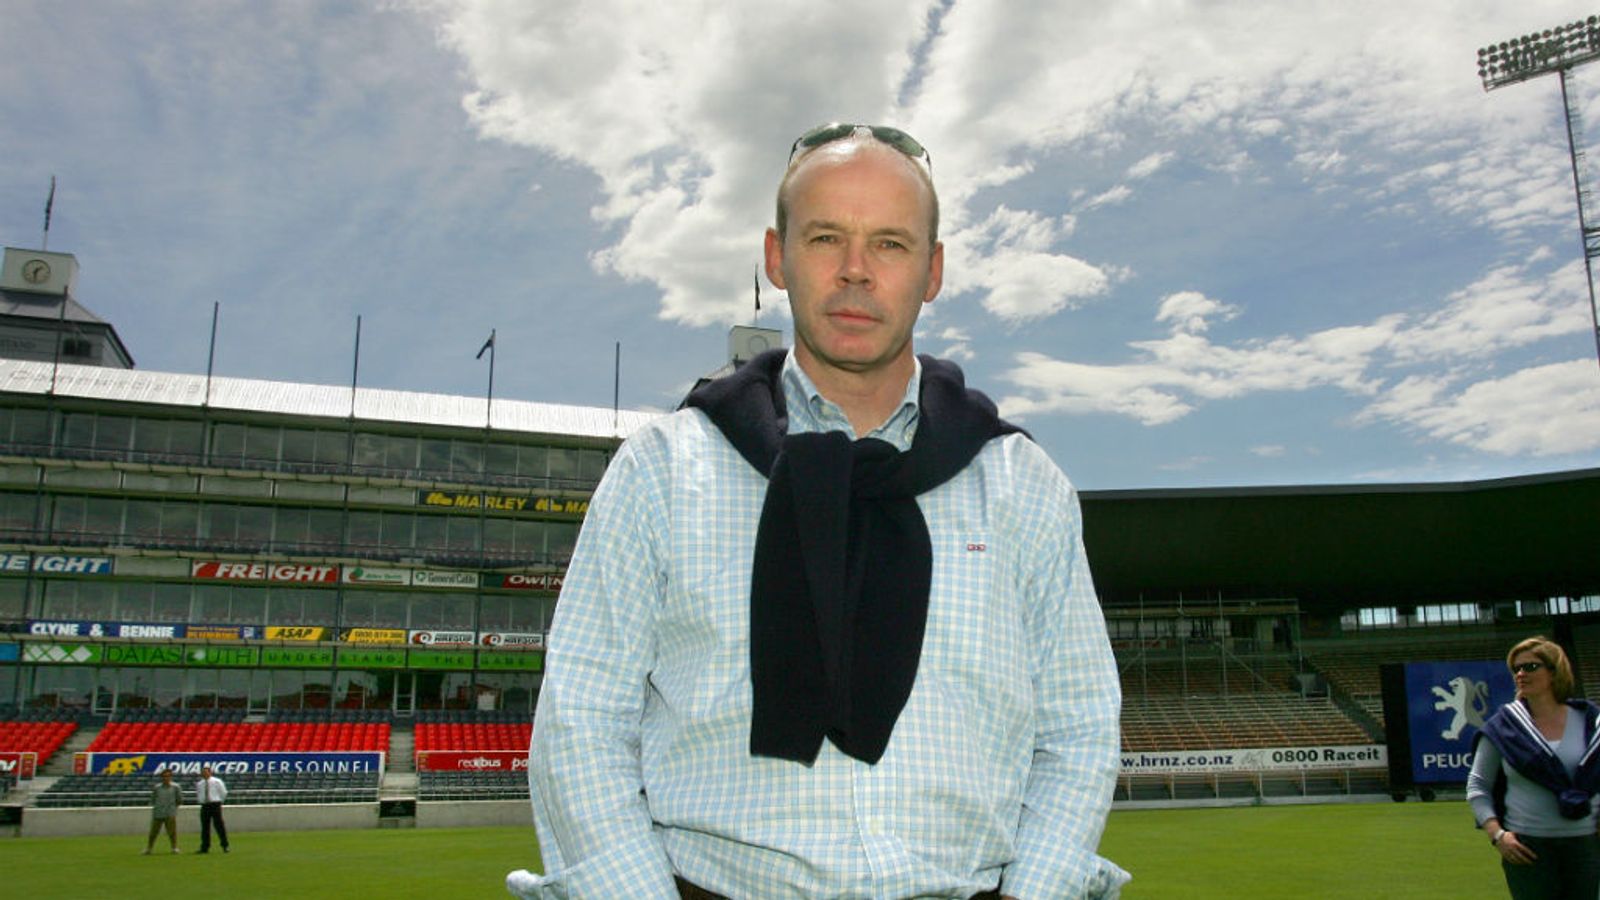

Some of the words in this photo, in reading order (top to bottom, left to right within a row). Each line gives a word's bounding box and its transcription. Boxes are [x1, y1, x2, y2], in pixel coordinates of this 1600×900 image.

[454, 494, 528, 511] MARLEY
[215, 562, 332, 581] FREIGHT
[30, 622, 79, 636] CLYNE
[89, 624, 104, 637] &
[119, 624, 175, 638] BENNIE
[275, 628, 313, 639] ASAP
[1271, 749, 1319, 763] 0800
[1323, 747, 1380, 761] Raceit
[154, 761, 249, 775] ADVANCED
[255, 760, 368, 774] PERSONNEL
